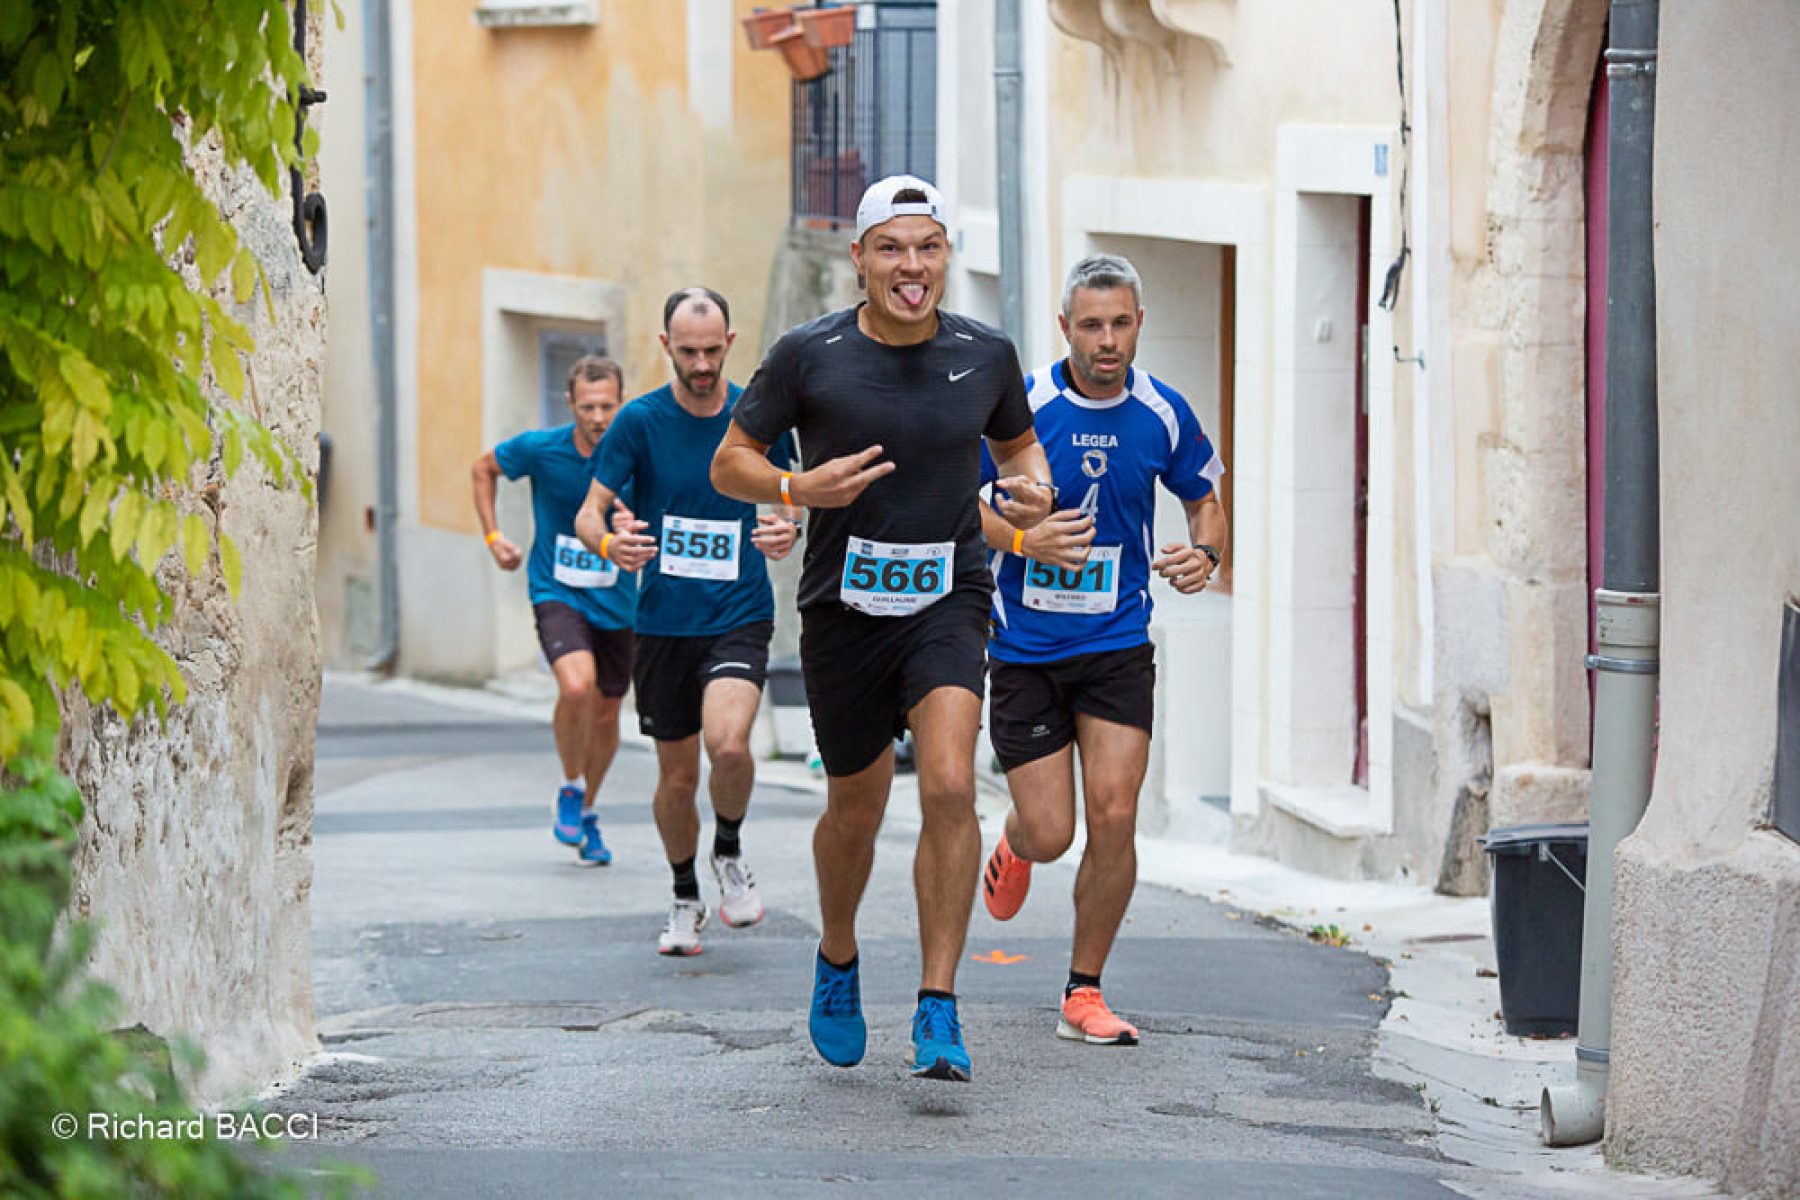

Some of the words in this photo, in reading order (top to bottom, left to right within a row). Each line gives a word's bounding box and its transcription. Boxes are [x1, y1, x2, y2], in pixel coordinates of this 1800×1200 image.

[1072, 433, 1118, 447] LEGEA
[667, 530, 729, 560] 558
[849, 555, 939, 593] 566
[1031, 560, 1104, 591] 501
